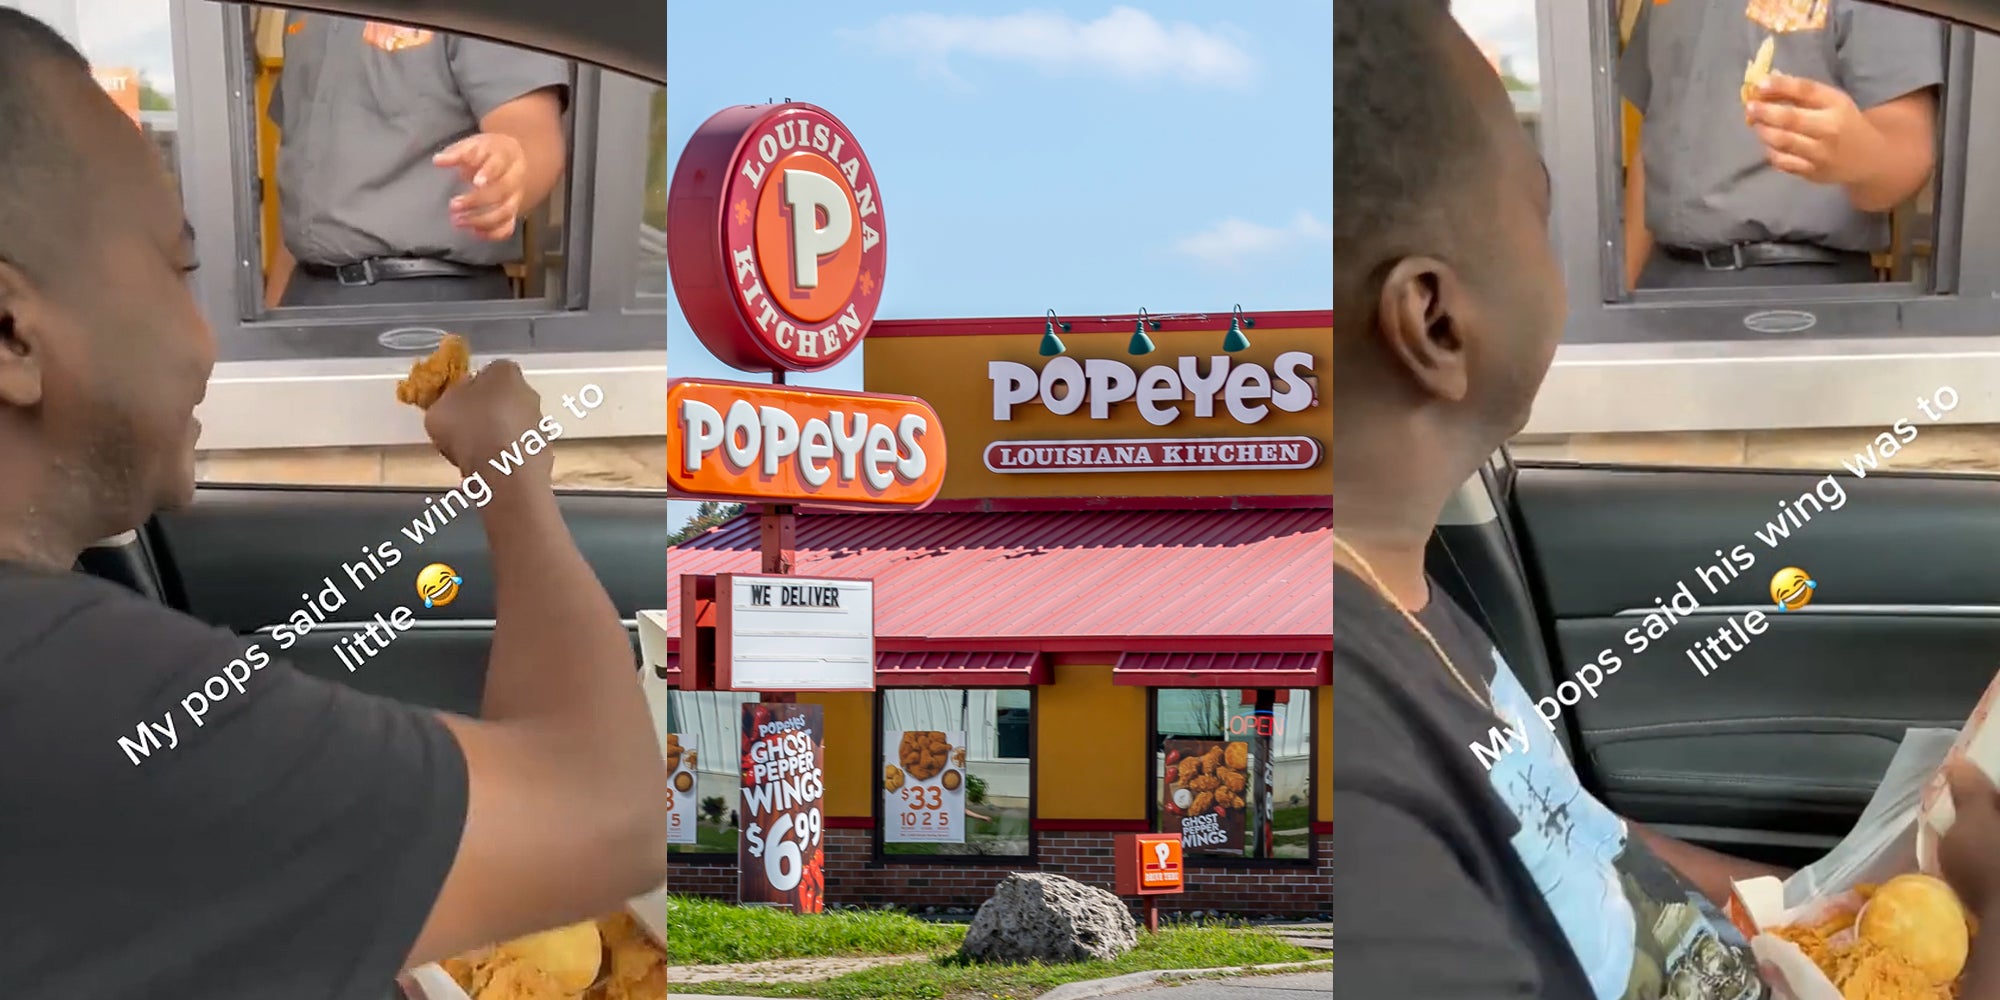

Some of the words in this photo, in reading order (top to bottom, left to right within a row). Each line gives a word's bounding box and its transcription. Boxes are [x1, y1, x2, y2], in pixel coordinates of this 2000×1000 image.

[741, 119, 880, 253] LOUISIANA
[783, 168, 852, 289] P
[734, 245, 862, 358] KITCHEN
[1000, 447, 1153, 466] LOUISIANA
[1162, 443, 1301, 463] KITCHEN
[751, 585, 771, 606] WE
[781, 586, 840, 608] DELIVER
[1230, 715, 1285, 736] OPEN
[750, 731, 812, 764] GHOST
[753, 751, 814, 784] PEPPER
[742, 768, 823, 817] WINGS
[901, 786, 943, 810] $33
[671, 813, 681, 827] 5
[900, 812, 916, 826] 10
[922, 812, 932, 825] 2
[939, 812, 949, 826] 5
[1181, 813, 1218, 827] GHOST
[1182, 823, 1219, 836] PEPPER
[1155, 843, 1170, 869] P
